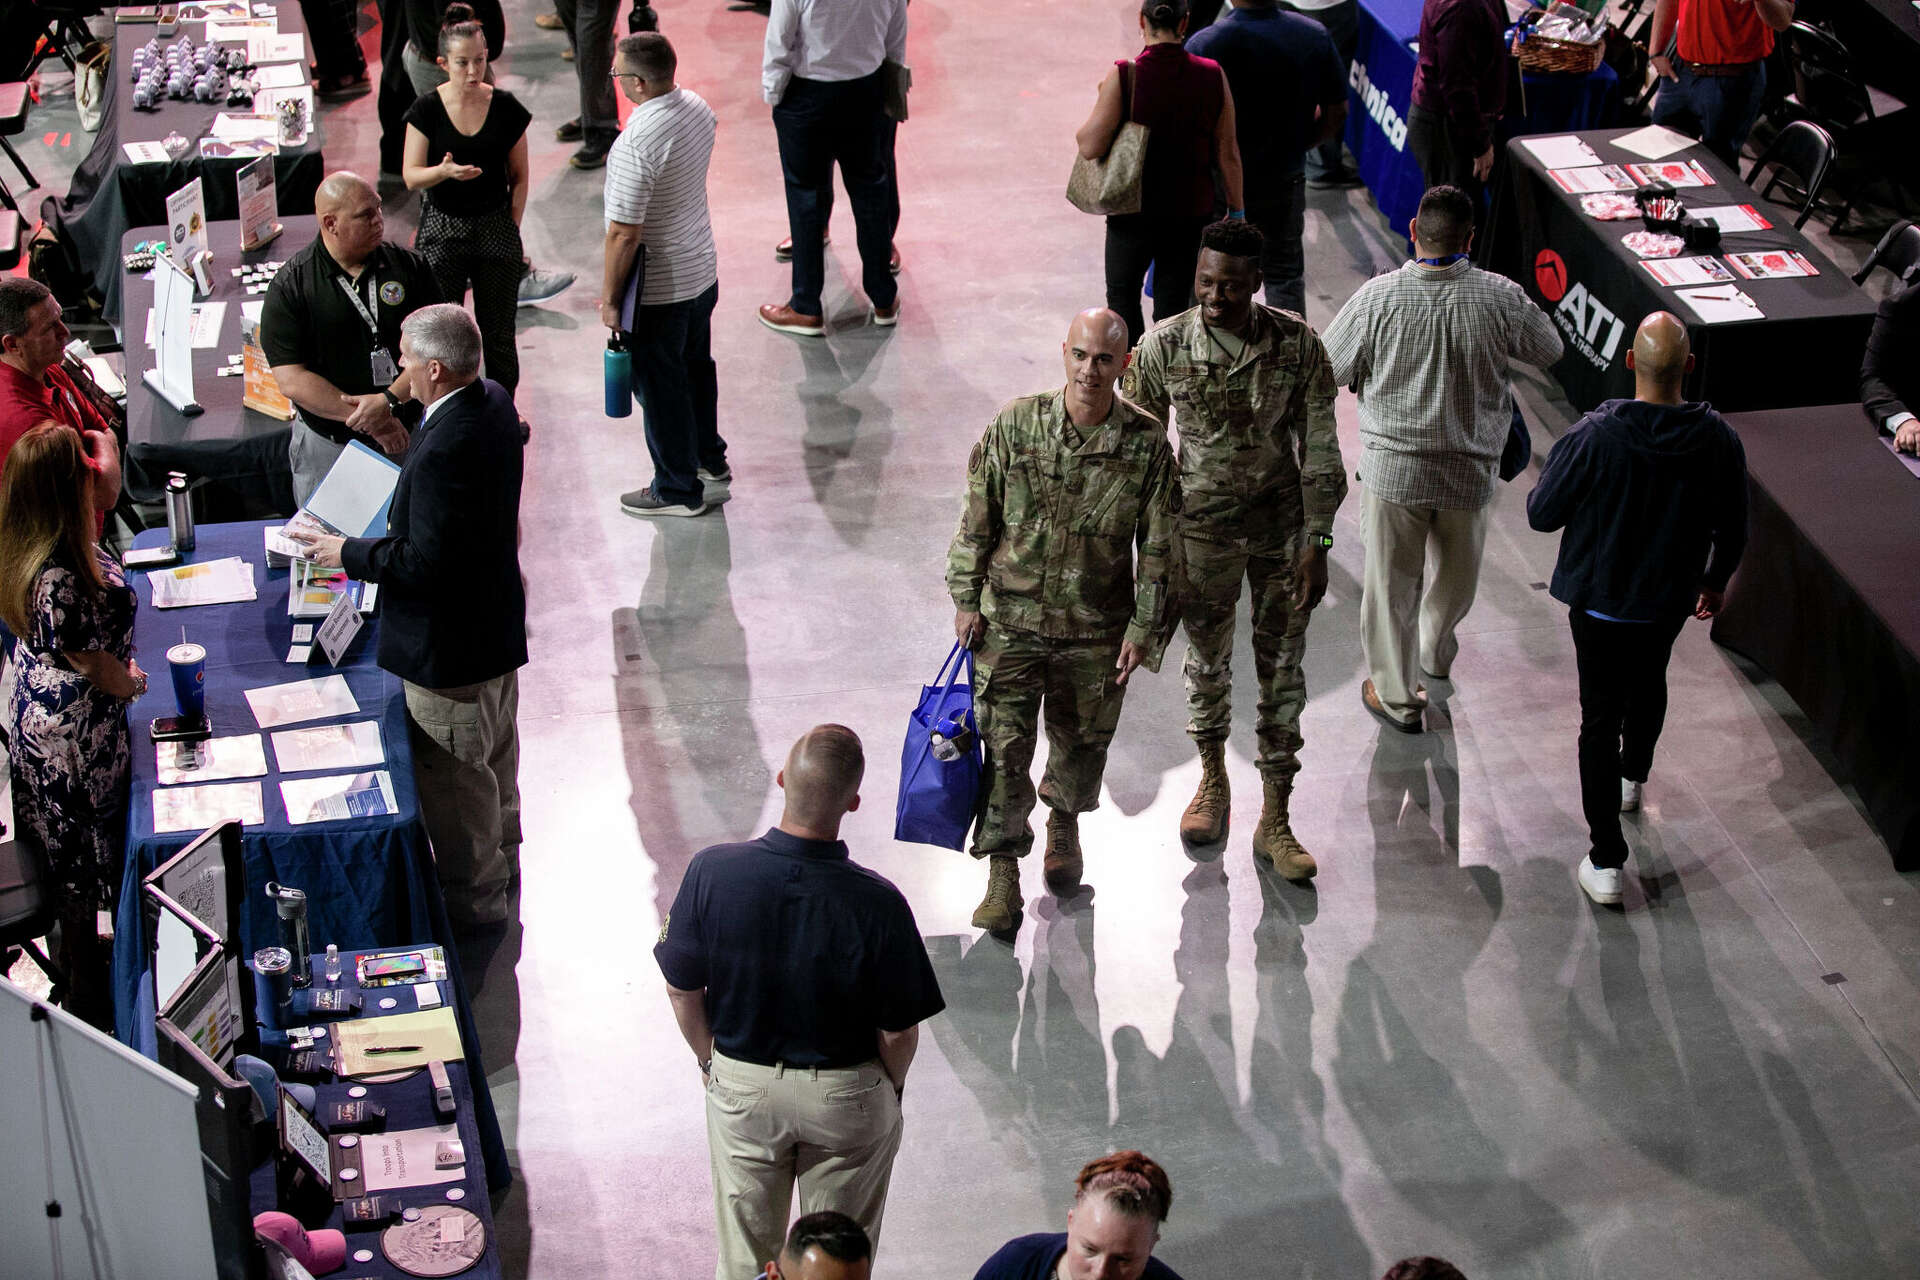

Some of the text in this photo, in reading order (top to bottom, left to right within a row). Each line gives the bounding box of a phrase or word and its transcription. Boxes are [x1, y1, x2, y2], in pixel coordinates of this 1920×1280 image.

[1349, 58, 1408, 152] chnica
[1558, 281, 1625, 361] ATI
[1577, 337, 1610, 371] THERAPY
[384, 1157, 392, 1176] Troops
